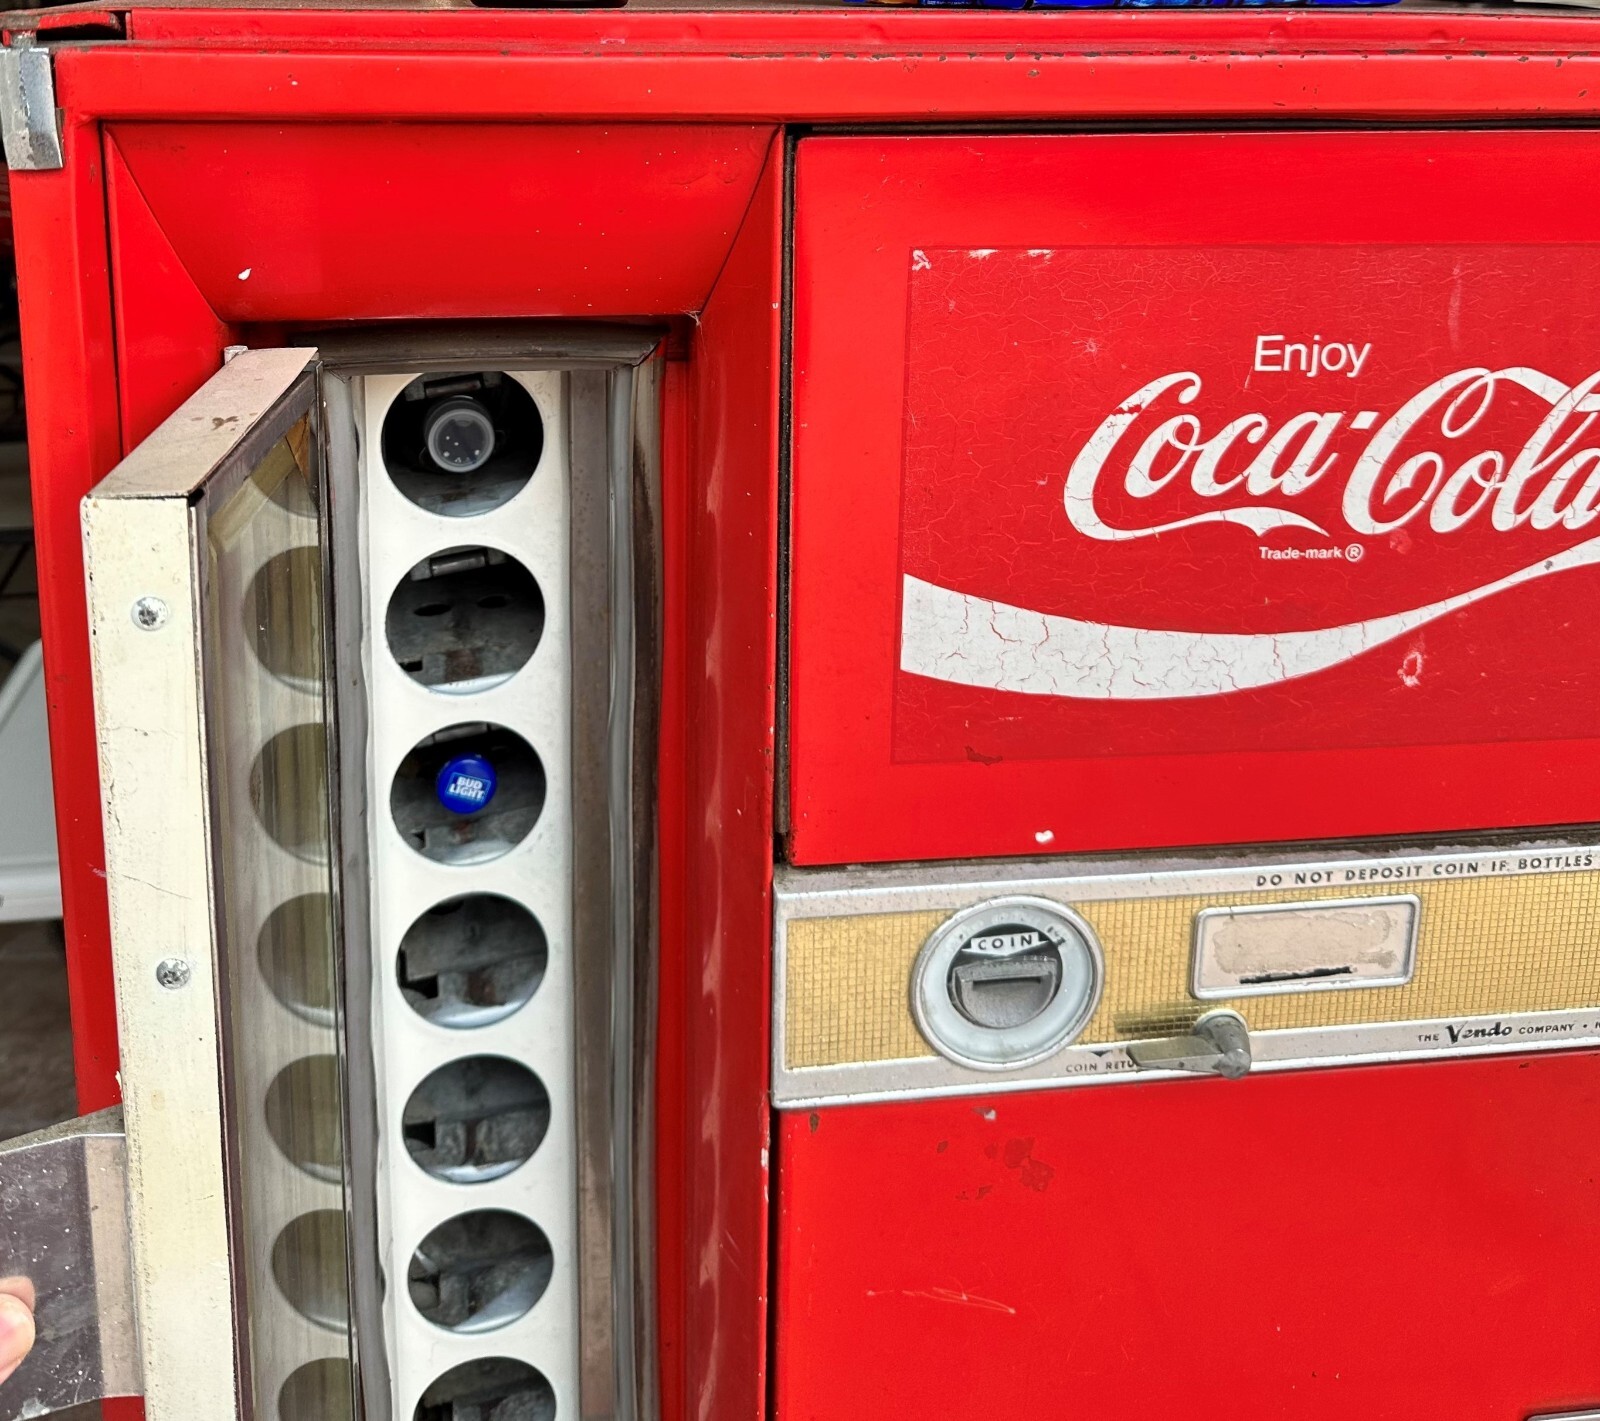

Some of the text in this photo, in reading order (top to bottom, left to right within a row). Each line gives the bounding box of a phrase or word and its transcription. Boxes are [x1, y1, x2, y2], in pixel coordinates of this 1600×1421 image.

[1254, 334, 1372, 378] Enjoy
[1063, 366, 1600, 541] Coca-Cola
[1258, 545, 1342, 560] Trade-mark
[449, 783, 485, 799] LIGHT
[456, 776, 483, 789] BUD
[1256, 854, 1593, 887] DO NOT DEPOSIT COIN IF BOTTLES
[977, 934, 1033, 951] COIN
[1417, 1021, 1575, 1044] THE Vendo COMPANY
[1066, 1059, 1135, 1073] COIN RETU
